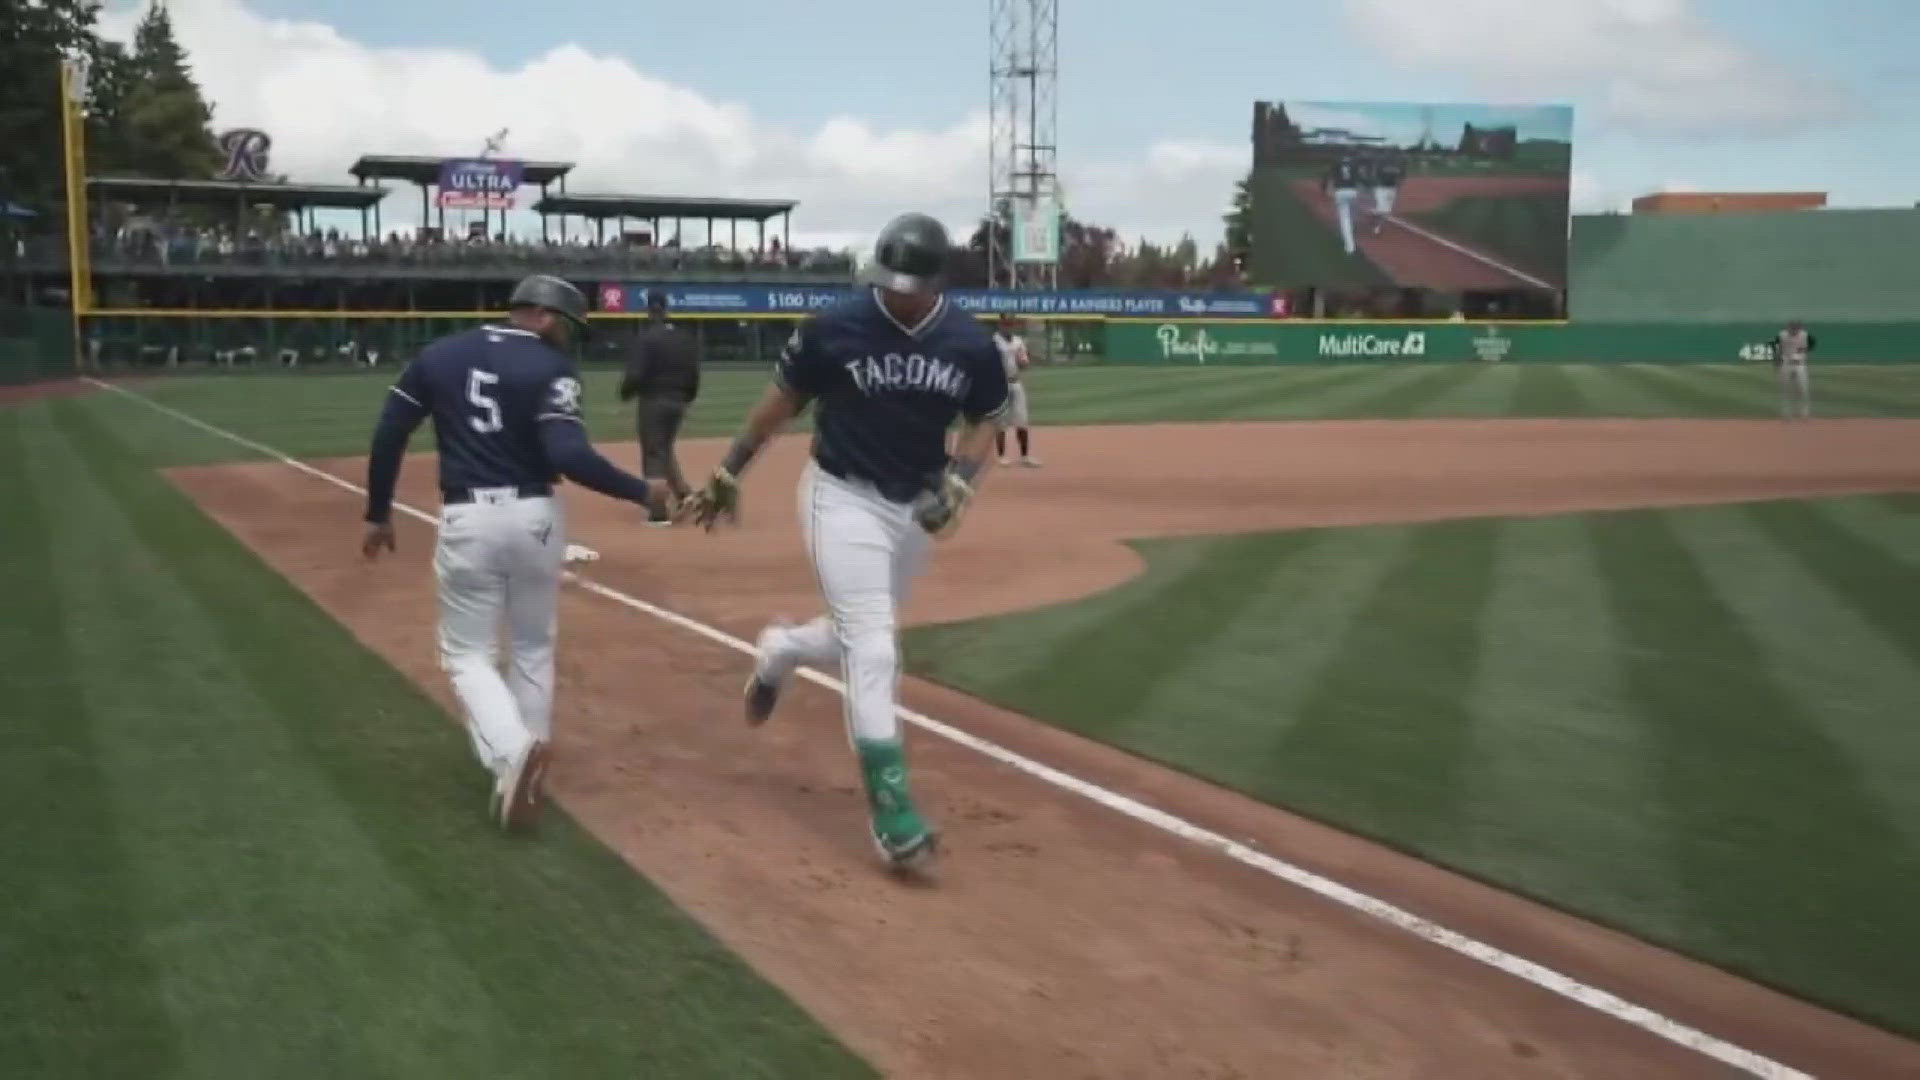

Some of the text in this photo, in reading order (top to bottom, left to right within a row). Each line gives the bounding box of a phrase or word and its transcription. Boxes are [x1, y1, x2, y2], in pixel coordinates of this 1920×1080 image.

[451, 172, 513, 189] ULTRA
[768, 292, 803, 309] $100
[1020, 297, 1039, 312] HIT
[1058, 297, 1069, 312] A
[1319, 334, 1400, 355] MultiCare
[465, 367, 503, 434] 5
